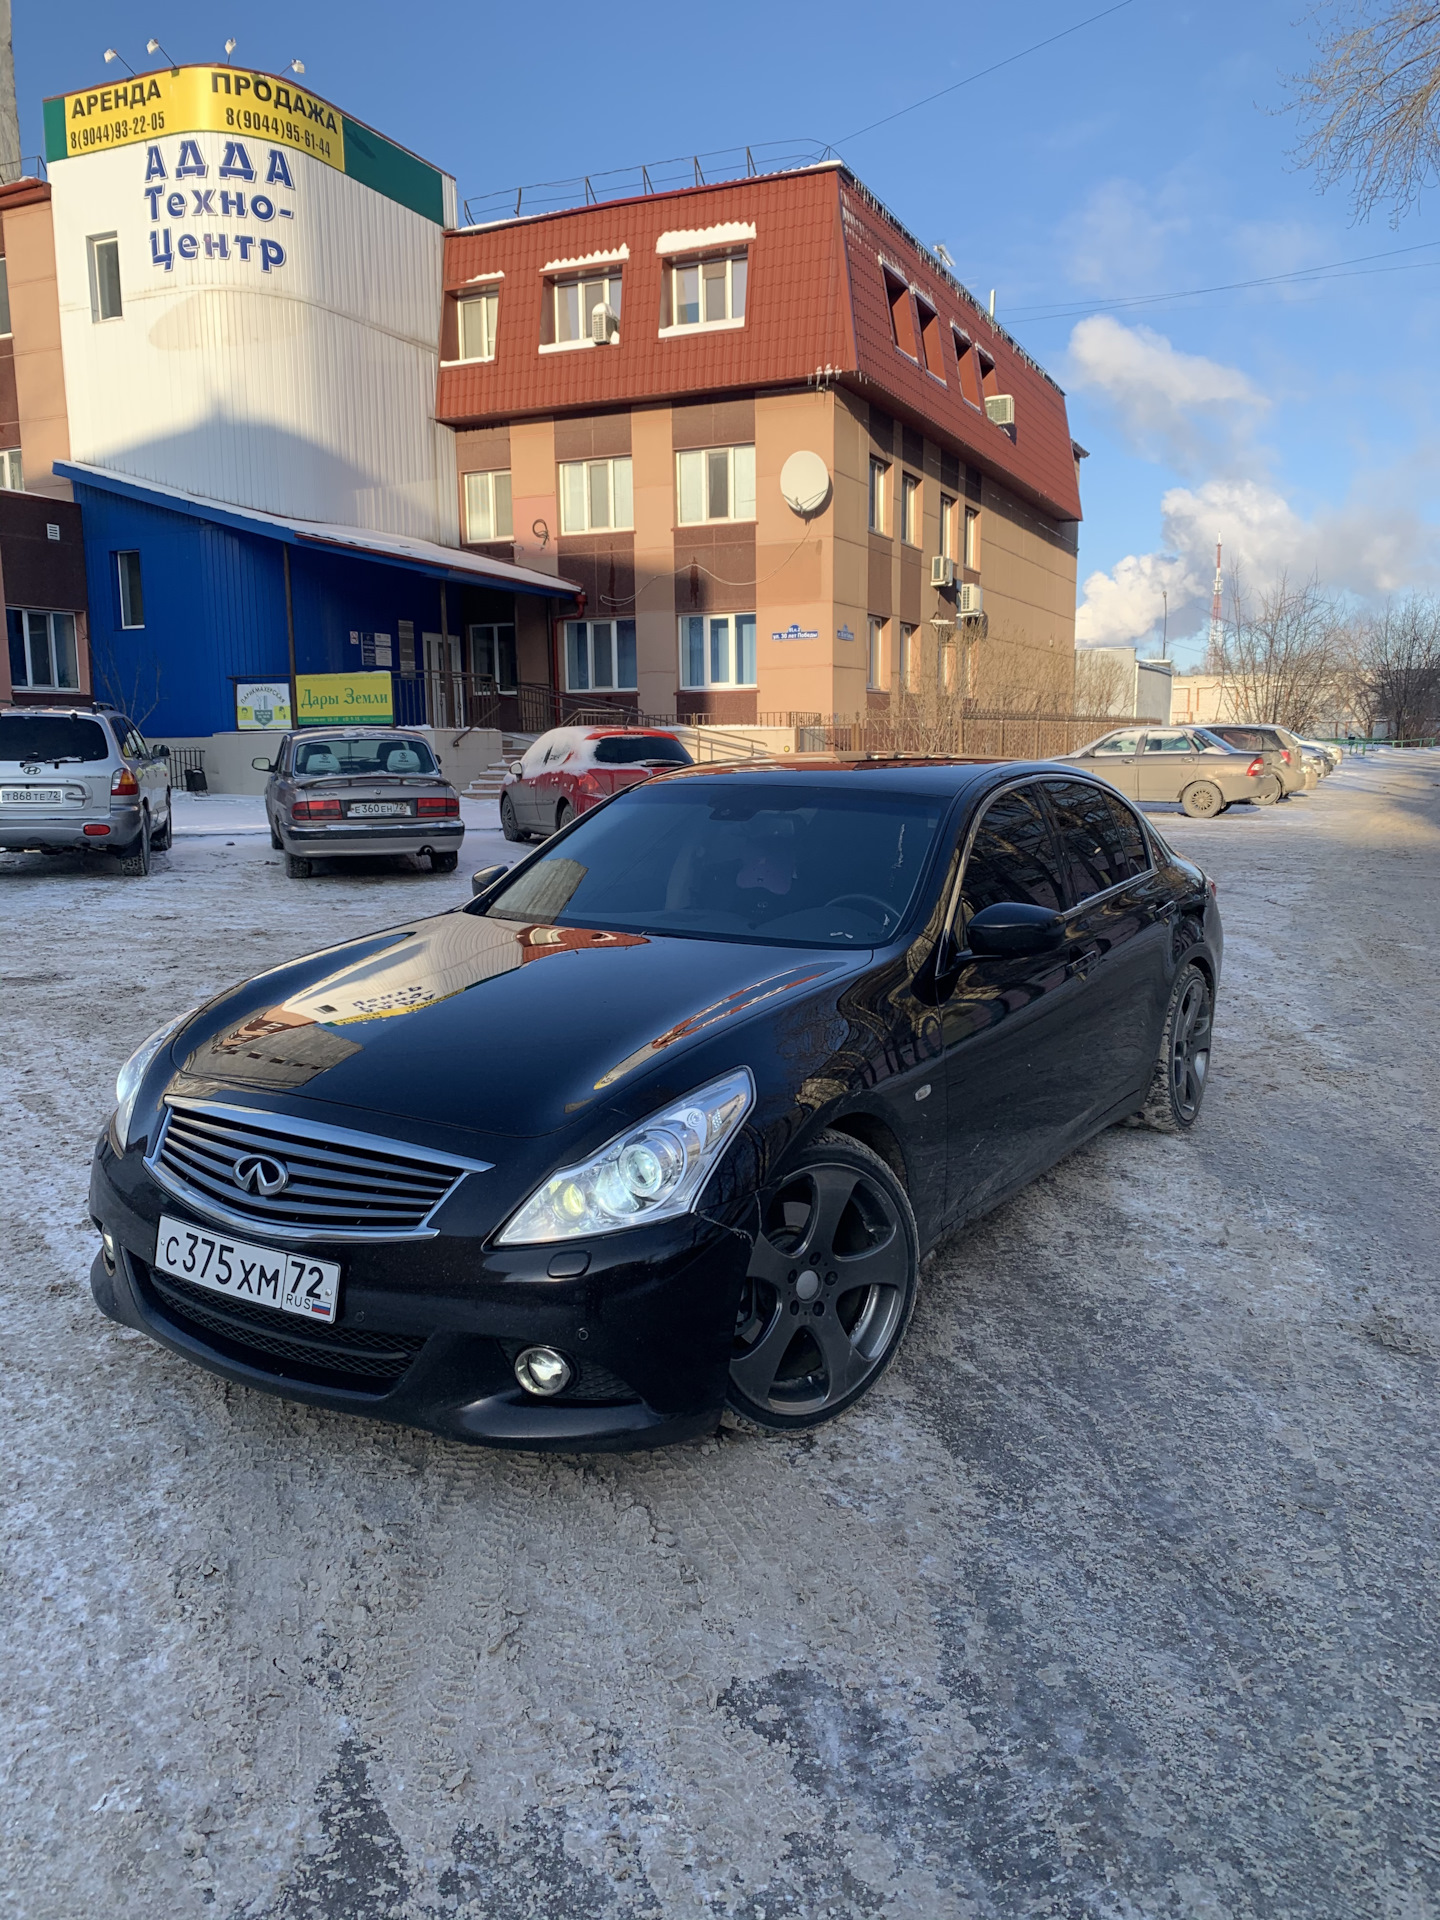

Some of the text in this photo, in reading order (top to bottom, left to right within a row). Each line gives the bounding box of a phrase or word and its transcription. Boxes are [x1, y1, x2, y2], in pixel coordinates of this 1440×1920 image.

[71, 79, 162, 119] АРЕНДА
[211, 72, 338, 134] ПРОДАЖА
[70, 111, 165, 149] 8(9044)93-22-05
[225, 107, 331, 158] 8(9044)95-61-44
[145, 139, 295, 189] АДДА
[144, 183, 293, 221] Техно-
[149, 227, 286, 273] Центр
[301, 687, 388, 709] Дары Земли
[290, 1260, 324, 1300] 72
[285, 1293, 311, 1310] RUS
